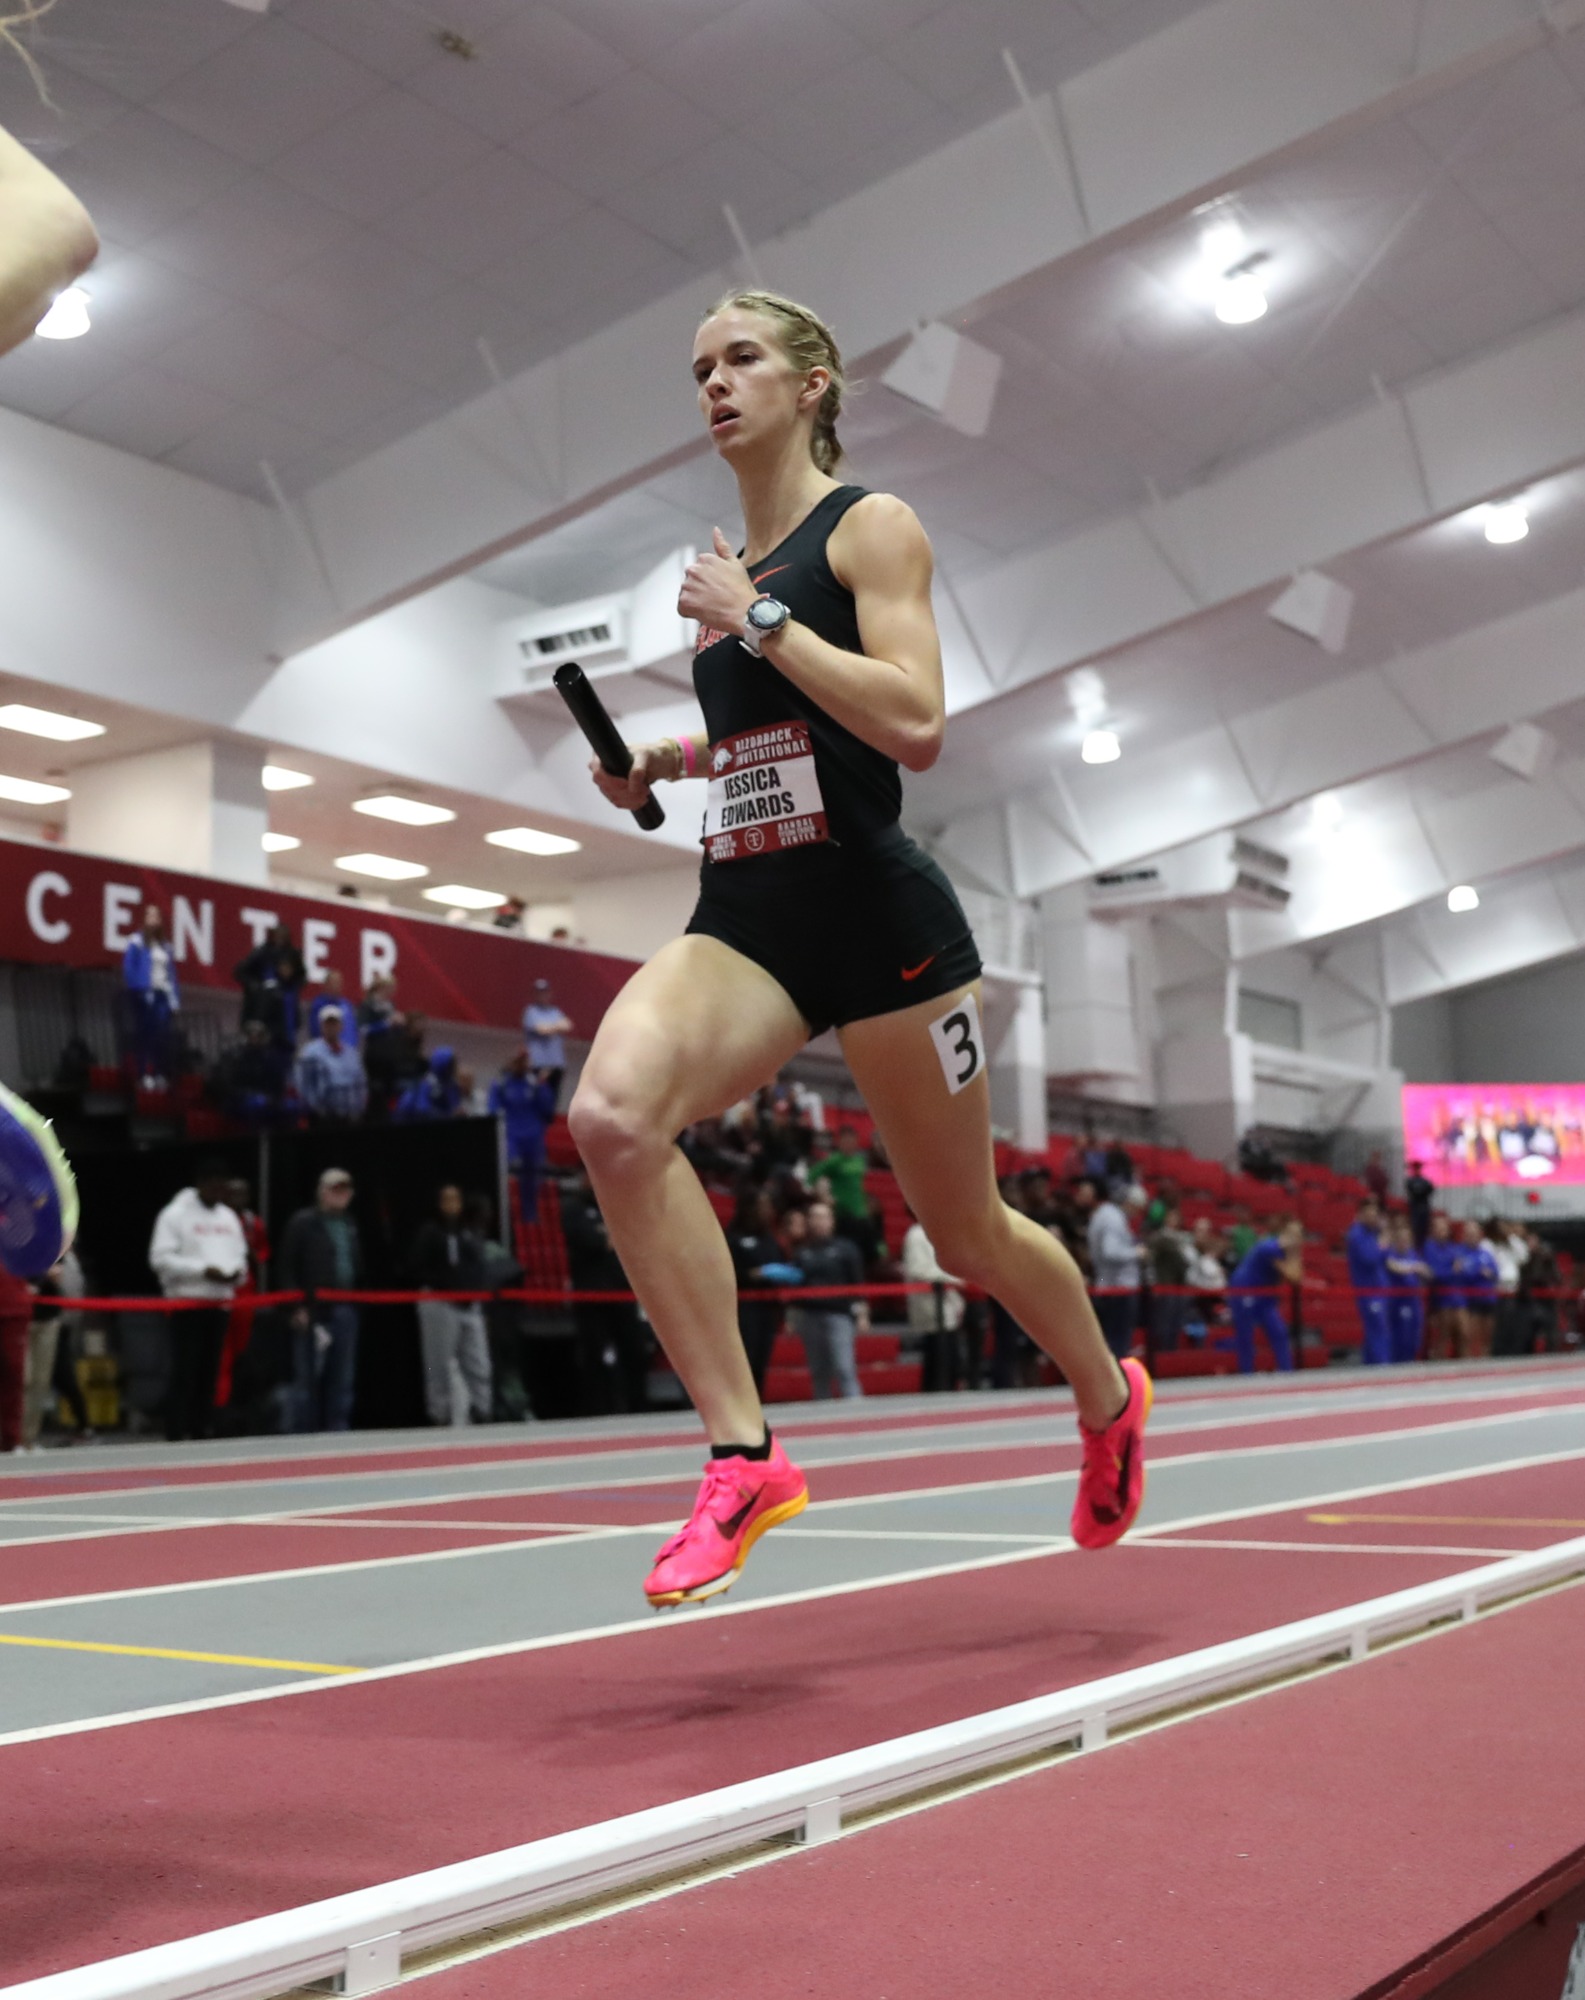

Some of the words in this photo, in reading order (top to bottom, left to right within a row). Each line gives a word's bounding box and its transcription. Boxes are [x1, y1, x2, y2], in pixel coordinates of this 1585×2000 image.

[735, 727, 793, 753] RAZORBACK
[735, 739, 808, 767] INVITATIONAL
[724, 766, 781, 800] JESSICA
[721, 791, 795, 828] EDWARDS
[26, 870, 398, 990] CENTER
[942, 1011, 978, 1084] 3
